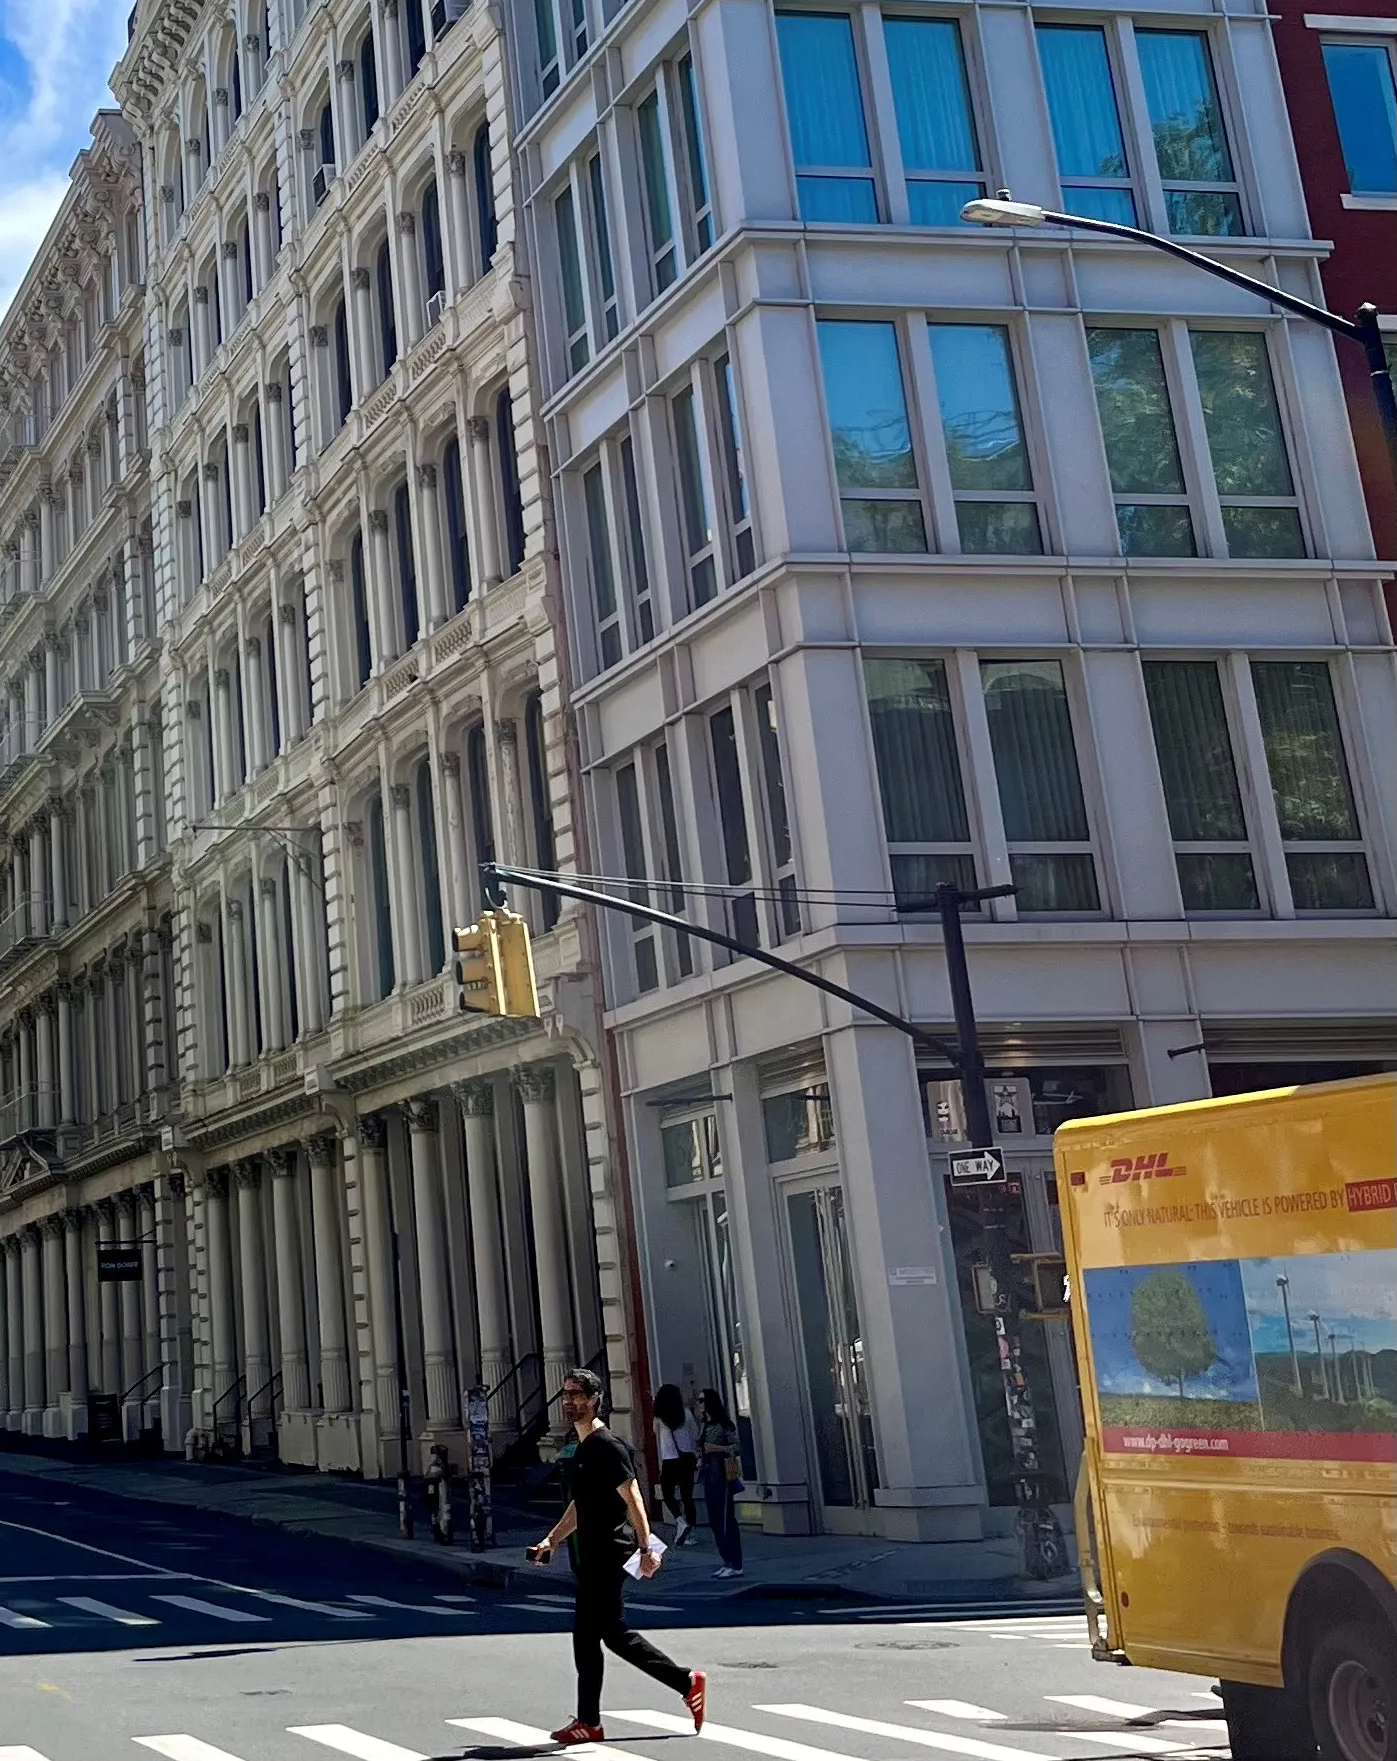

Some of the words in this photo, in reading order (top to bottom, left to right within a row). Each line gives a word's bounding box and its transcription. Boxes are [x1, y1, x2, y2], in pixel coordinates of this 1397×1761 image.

[956, 1161, 970, 1174] ONE
[975, 1160, 994, 1172] WAY
[1109, 1152, 1174, 1184] DHL
[1121, 1208, 1145, 1227] ONLY
[1194, 1201, 1217, 1221] THIS
[1219, 1197, 1260, 1219] VEHICLE
[1263, 1197, 1272, 1215] IS
[1274, 1190, 1326, 1214] POWERED
[1330, 1188, 1346, 1209] BY
[1347, 1183, 1392, 1208] HYBRID
